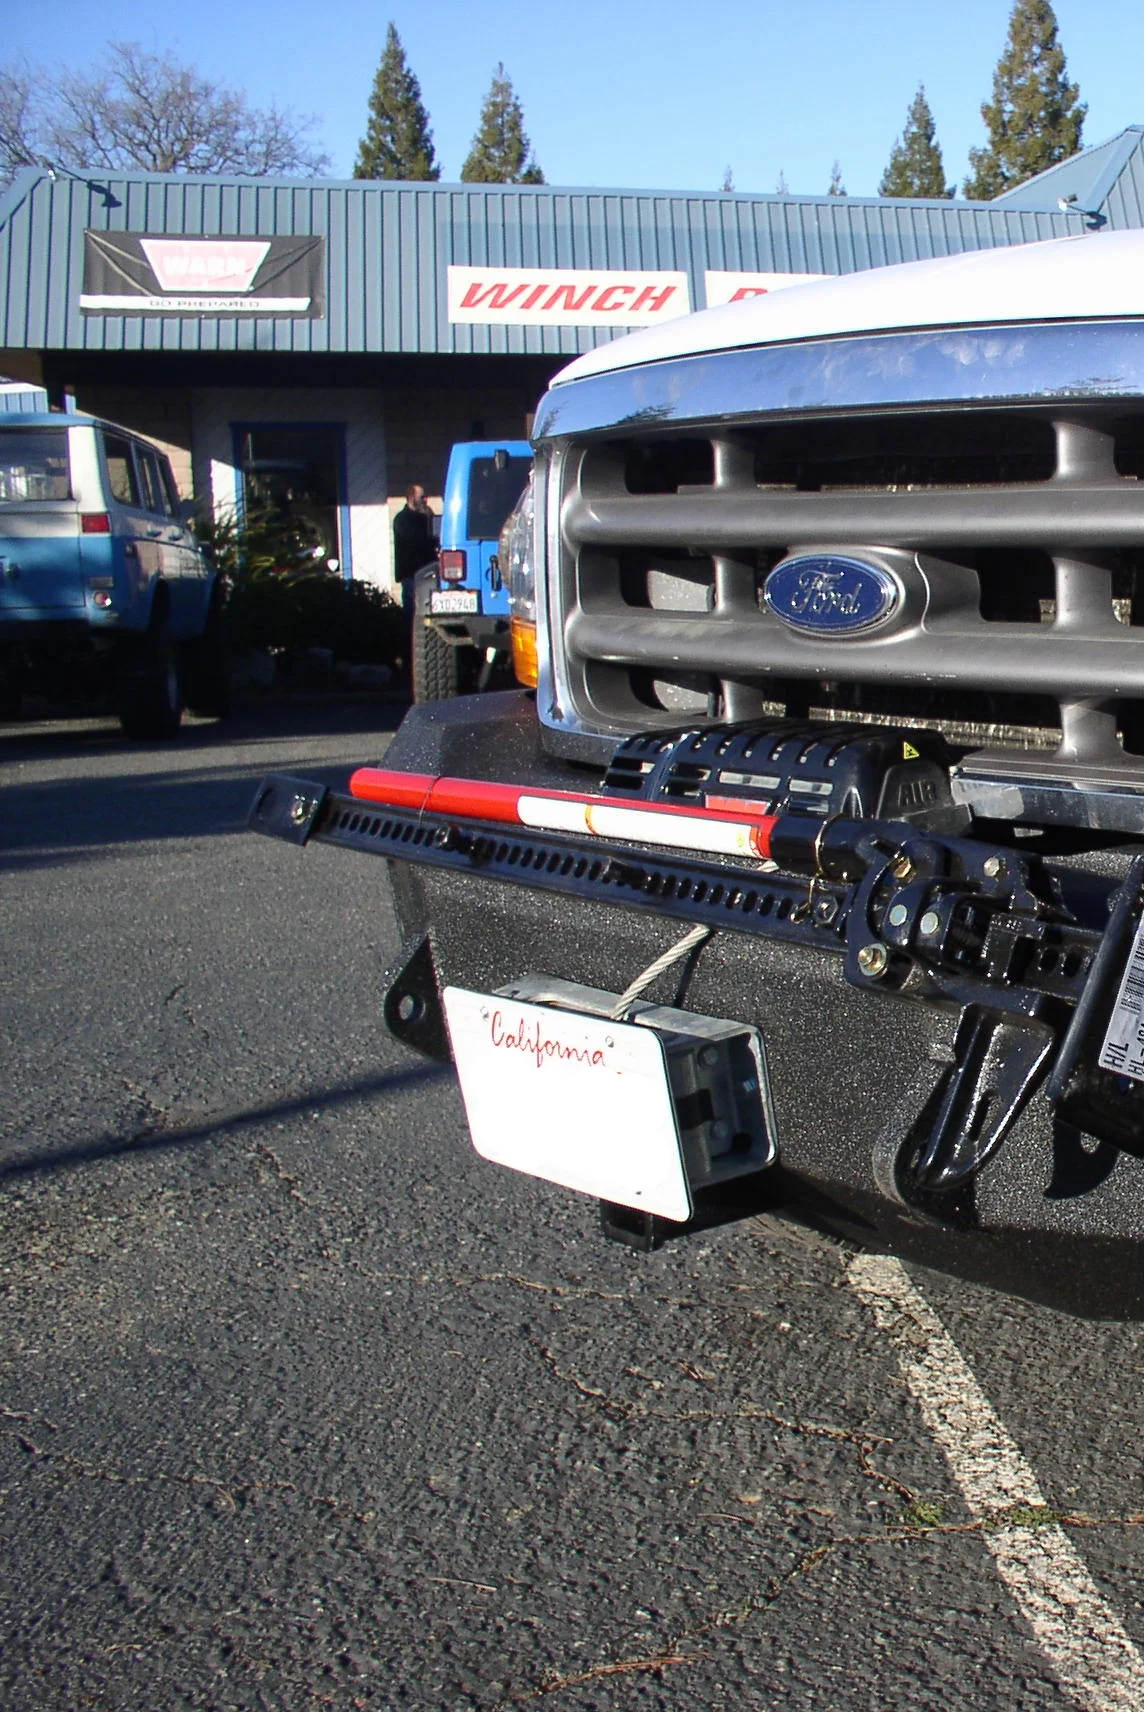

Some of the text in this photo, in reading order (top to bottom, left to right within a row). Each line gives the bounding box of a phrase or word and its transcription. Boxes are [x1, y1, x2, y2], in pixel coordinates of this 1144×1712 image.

[163, 255, 246, 276] WARN
[149, 299, 261, 308] GO PREPARED
[460, 282, 678, 313] WINCH
[791, 569, 863, 615] Ford
[491, 1010, 607, 1068] California
[1103, 1041, 1130, 1069] H/L
